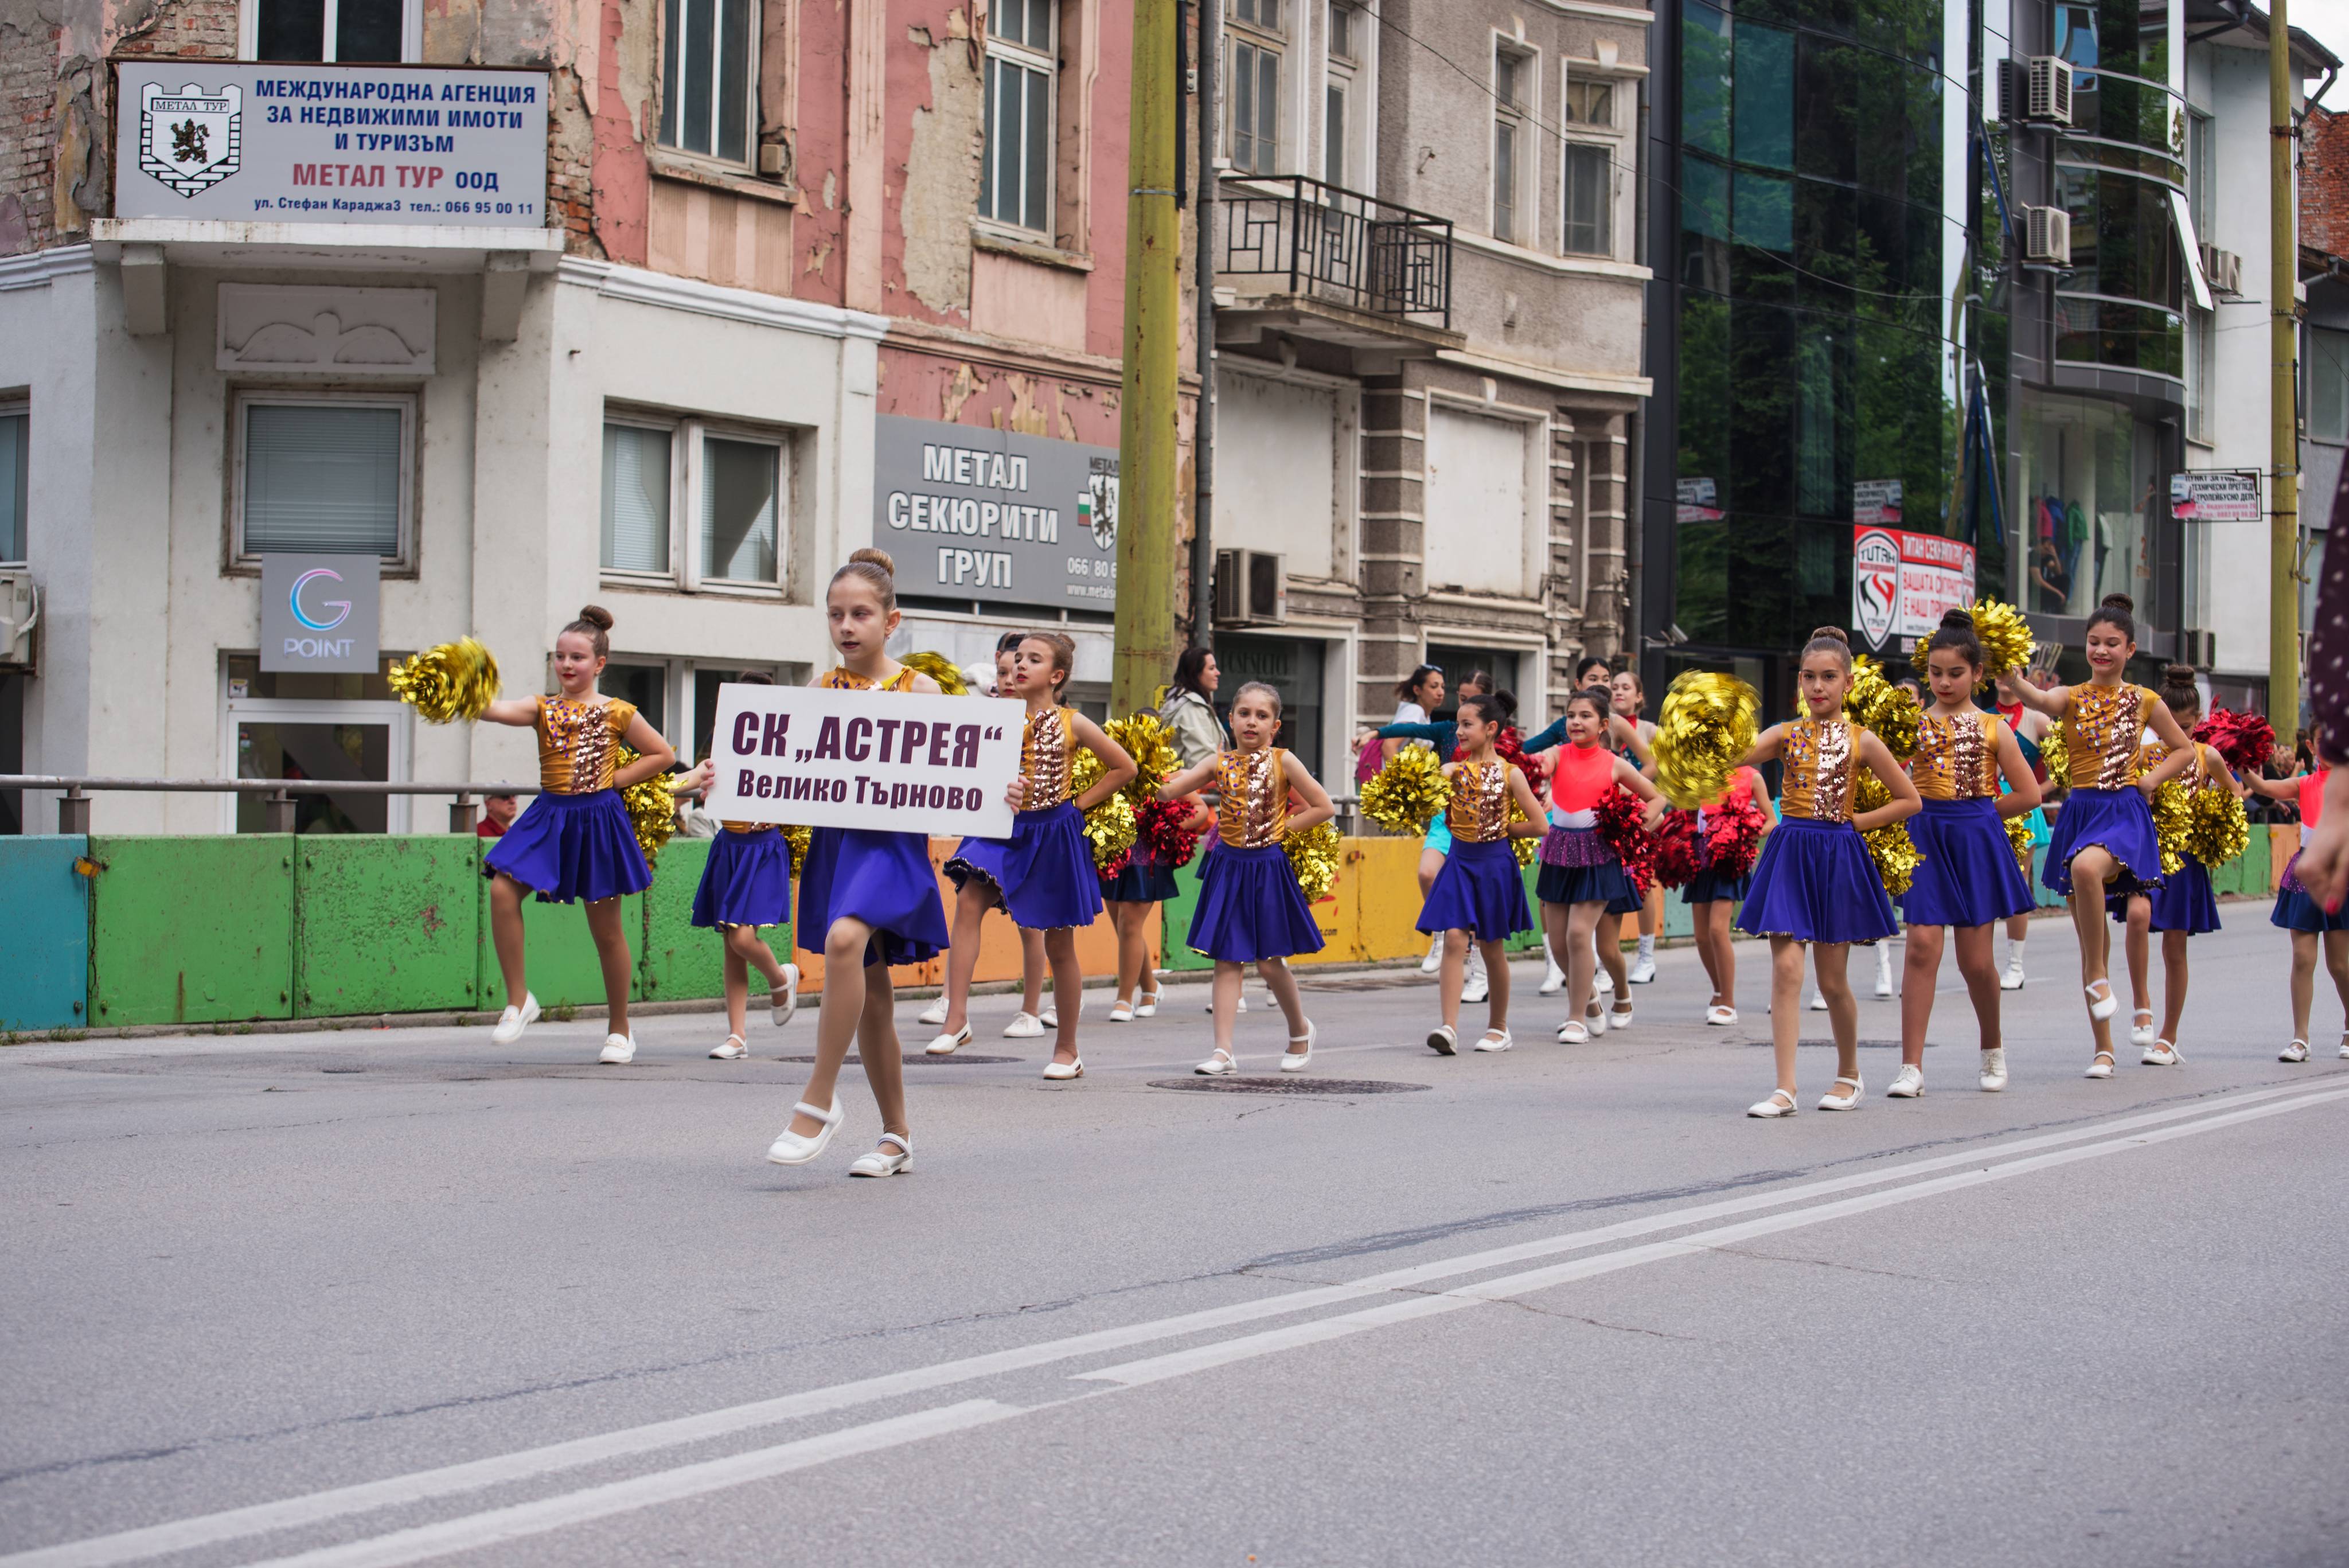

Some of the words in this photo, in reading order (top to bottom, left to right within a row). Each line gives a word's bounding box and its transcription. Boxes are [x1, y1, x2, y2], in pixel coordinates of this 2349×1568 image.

[256, 80, 434, 102] МЕЖДУНАРОДНА
[440, 84, 536, 104] АГЕНЦИЯ
[155, 100, 197, 112] МЕТАЛ
[204, 102, 228, 112] ТУР
[267, 106, 293, 124] ЗА
[301, 107, 440, 128] НЕДВИЖИМИ
[448, 110, 523, 130] ИМОТИ
[335, 133, 349, 151] И
[356, 133, 455, 153] ТУРИЗЪМ
[293, 163, 386, 188] МЕТАЛ
[396, 166, 445, 189] ТУР
[455, 171, 500, 193] ООД
[255, 200, 274, 212] ул.
[278, 197, 329, 212] Стефан
[410, 203, 441, 213] тел.:
[445, 201, 471, 214] 066
[475, 202, 491, 214] 95
[496, 202, 513, 214] 00
[518, 204, 533, 215] 11
[922, 444, 1028, 492] МЕТАЛ
[888, 491, 1059, 544] СЕКЮРИТИ
[937, 547, 1013, 588] ГРУП
[1094, 559, 1109, 578] 80
[290, 568, 352, 631] G
[284, 638, 355, 658] POINT
[732, 711, 792, 758] СК
[736, 768, 849, 804] Велико
[854, 775, 984, 813] Търново
